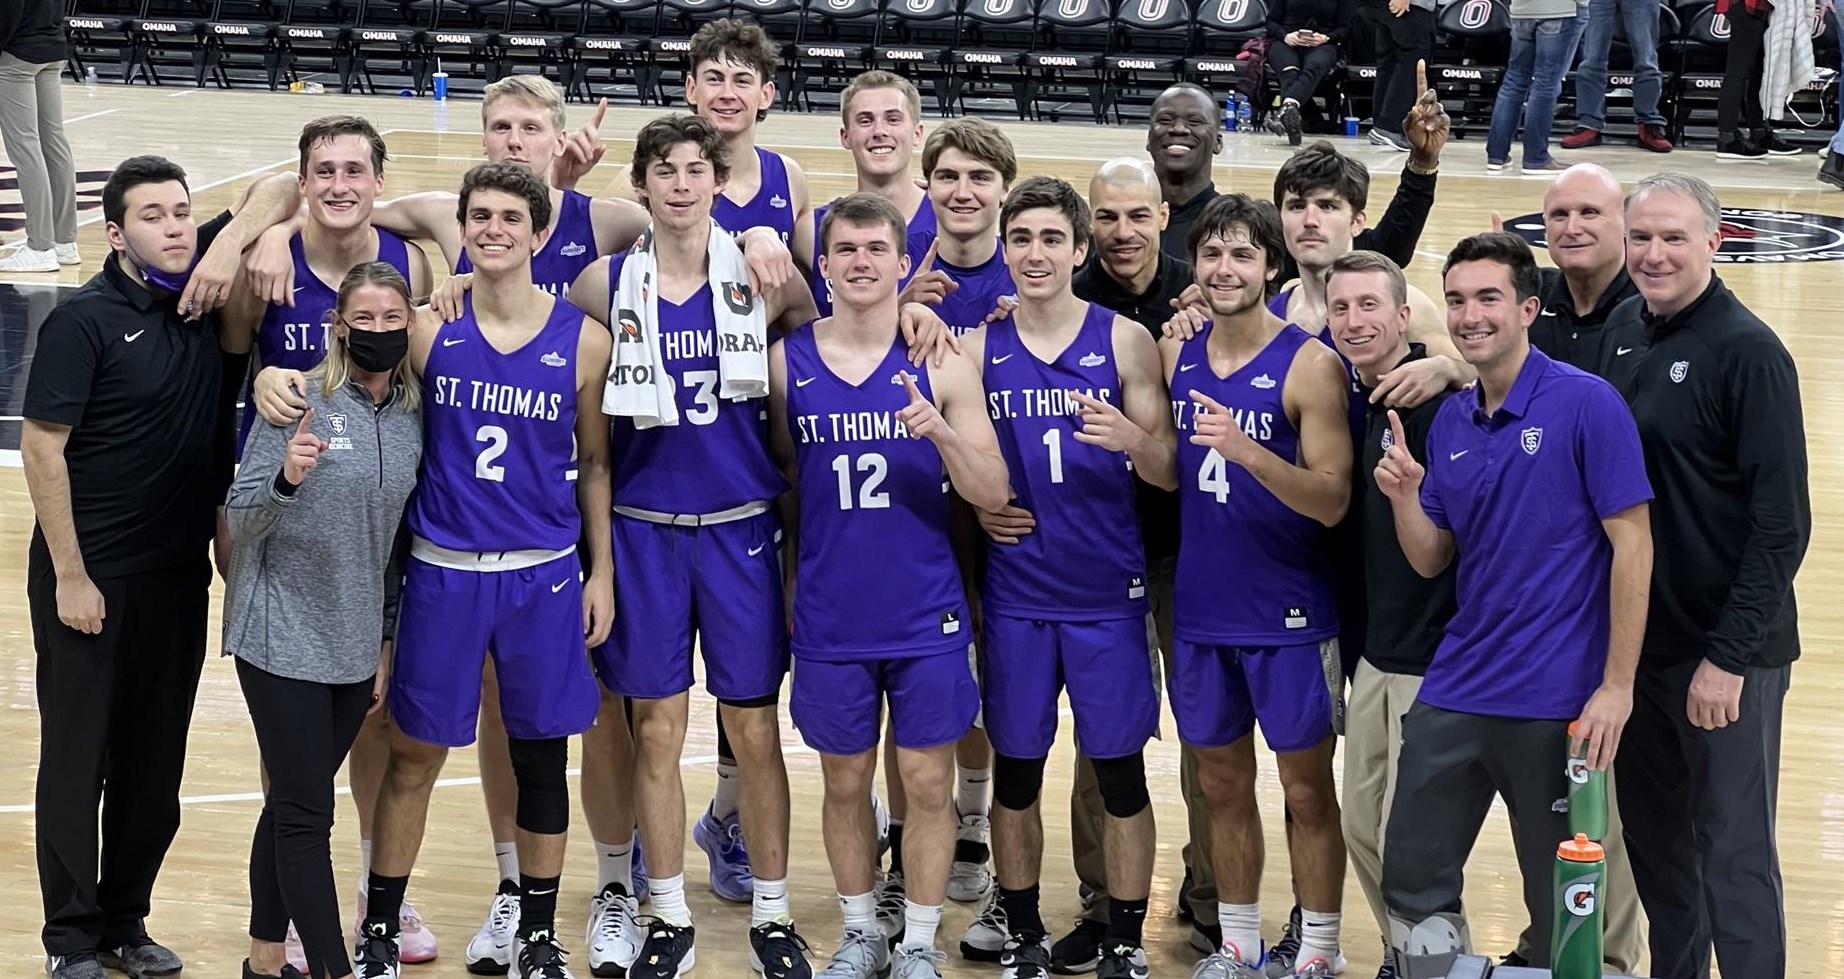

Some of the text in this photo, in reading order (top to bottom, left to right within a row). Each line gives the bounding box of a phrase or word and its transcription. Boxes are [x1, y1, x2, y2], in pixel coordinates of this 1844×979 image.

[69, 19, 104, 29] OMAHA
[142, 22, 177, 32] OMAHA
[214, 25, 249, 35] OMAHA
[288, 28, 324, 38] OMAHA
[362, 31, 397, 41] OMAHA
[436, 33, 471, 44] OMAHA
[510, 37, 546, 47] OMAHA
[586, 40, 622, 50] OMAHA
[661, 42, 691, 51] OMAH
[808, 48, 845, 58] OMAHA
[886, 51, 923, 60] OMAHA
[964, 54, 1002, 64] OMAHA
[1039, 56, 1077, 66] OMAHA
[1117, 60, 1156, 69] OMAHA
[1197, 62, 1235, 72] OMAHA
[1442, 69, 1481, 79] OMAHA
[1695, 79, 1722, 88] OMA
[284, 323, 315, 350] ST.
[659, 330, 720, 360] HOM
[435, 375, 562, 421] ST. THOMAS
[667, 370, 719, 425] 3
[989, 390, 1017, 420] ST.
[1193, 402, 1273, 440] TMAS
[797, 411, 915, 443] ST. THOMA
[475, 425, 508, 482] 2
[1042, 428, 1064, 483] 1
[1198, 446, 1230, 504] 4
[832, 452, 890, 510] 12
[947, 613, 954, 621] L
[1290, 608, 1300, 616] M
[1564, 883, 1596, 917] G
